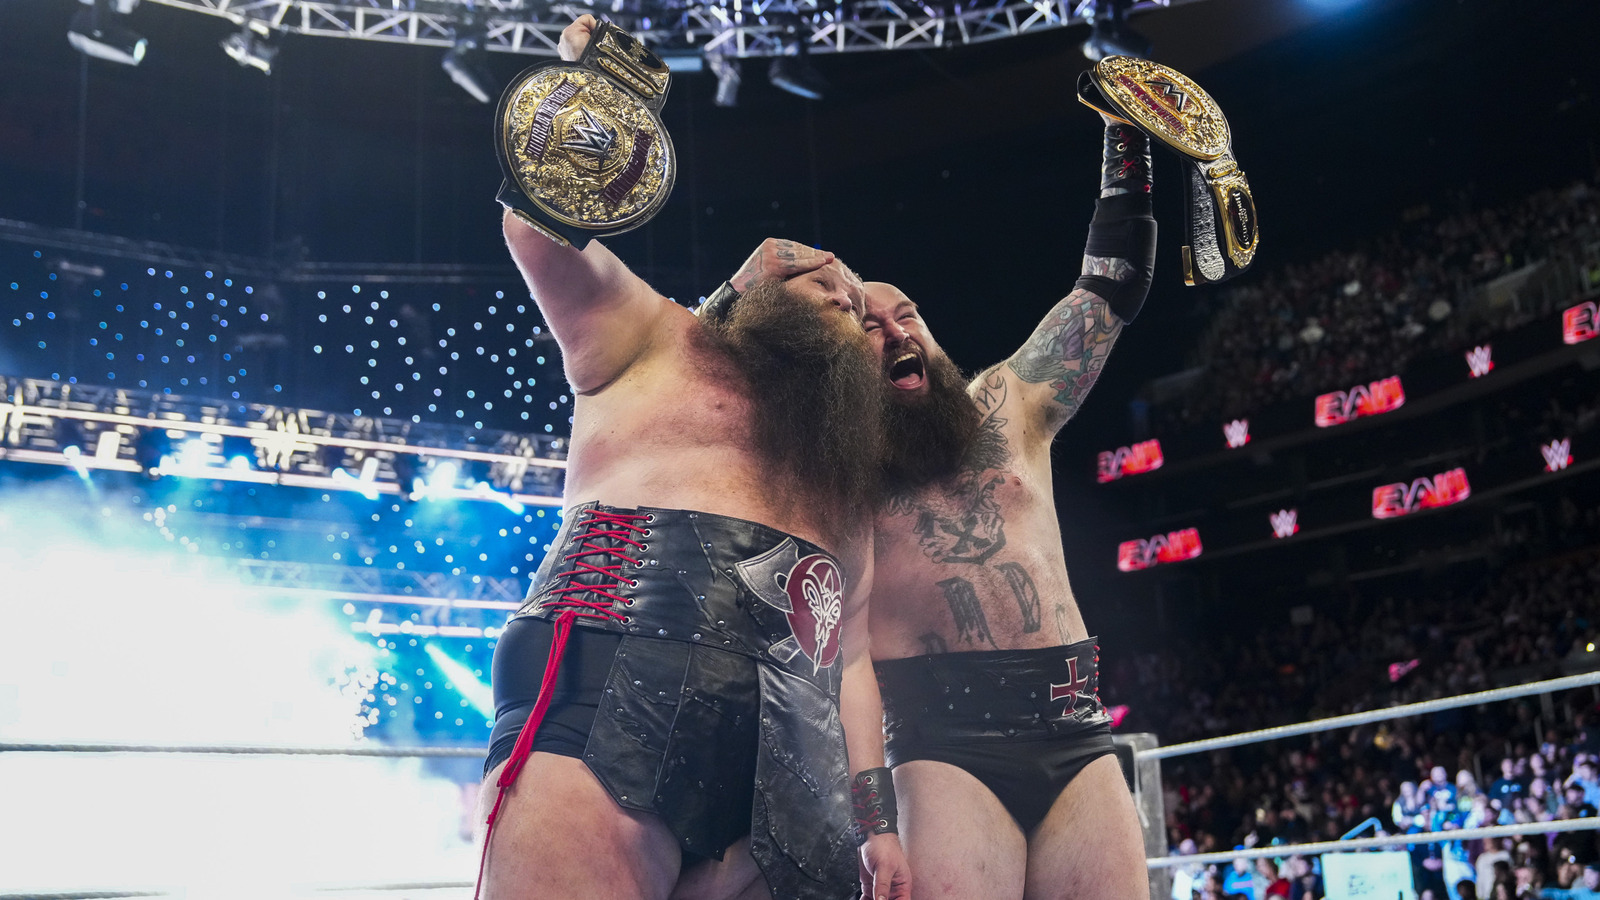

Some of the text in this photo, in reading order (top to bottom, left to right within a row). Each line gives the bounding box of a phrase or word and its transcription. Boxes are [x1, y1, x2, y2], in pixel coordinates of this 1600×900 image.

[1315, 375, 1405, 427] RAW
[1098, 438, 1164, 483] RAW
[1372, 467, 1470, 519] RAW
[1118, 527, 1203, 572] RAW
